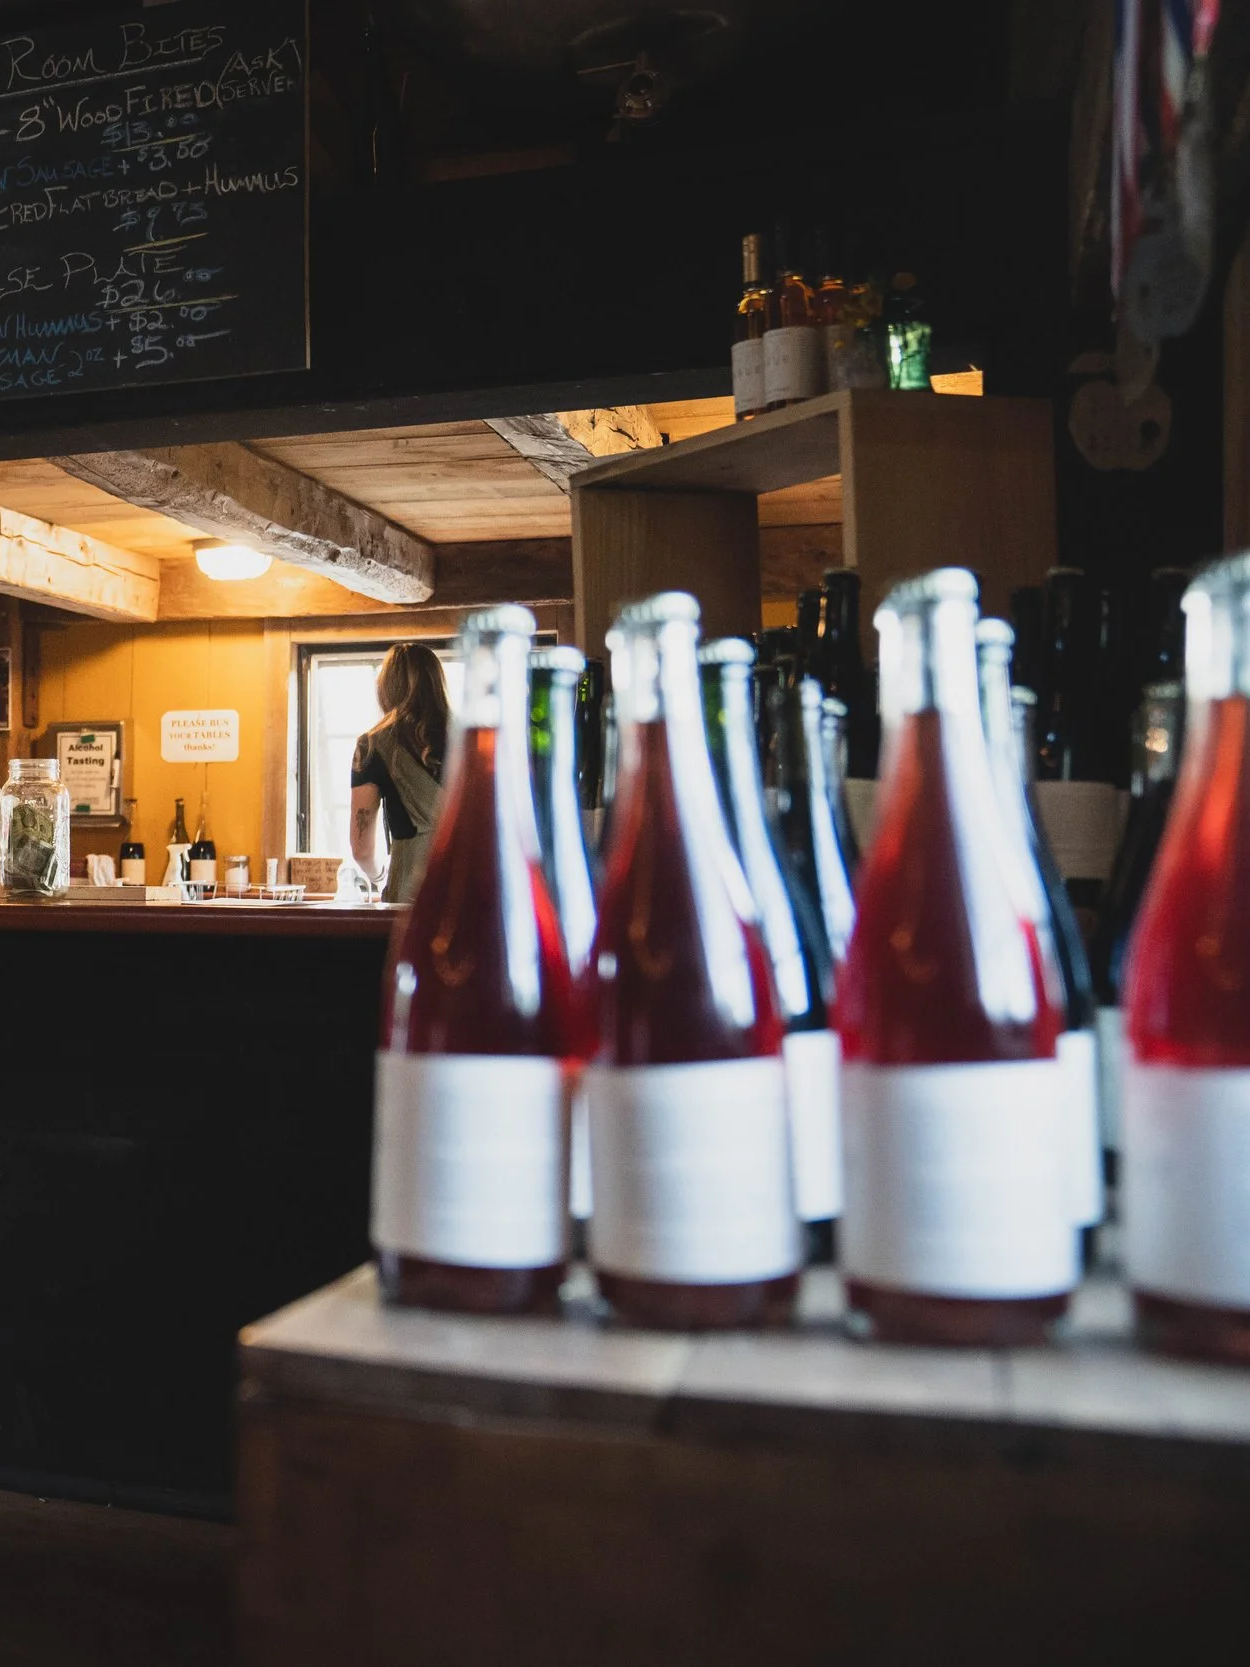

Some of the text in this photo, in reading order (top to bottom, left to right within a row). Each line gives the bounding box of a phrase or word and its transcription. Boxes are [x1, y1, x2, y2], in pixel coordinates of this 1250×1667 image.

[0, 35, 106, 89] ROOM
[119, 23, 225, 70] BITES
[57, 97, 122, 131] WOOD
[124, 80, 216, 115] FIRED
[17, 156, 113, 186] SAUSAGE
[205, 161, 298, 195] HUMMUS
[60, 246, 188, 288] PLATE
[16, 308, 102, 338] HUMMUS
[171, 718, 206, 729] PLEASE
[194, 731, 231, 740] TABLES
[66, 757, 105, 767] Tasting
[68, 743, 104, 752] Alcohol
